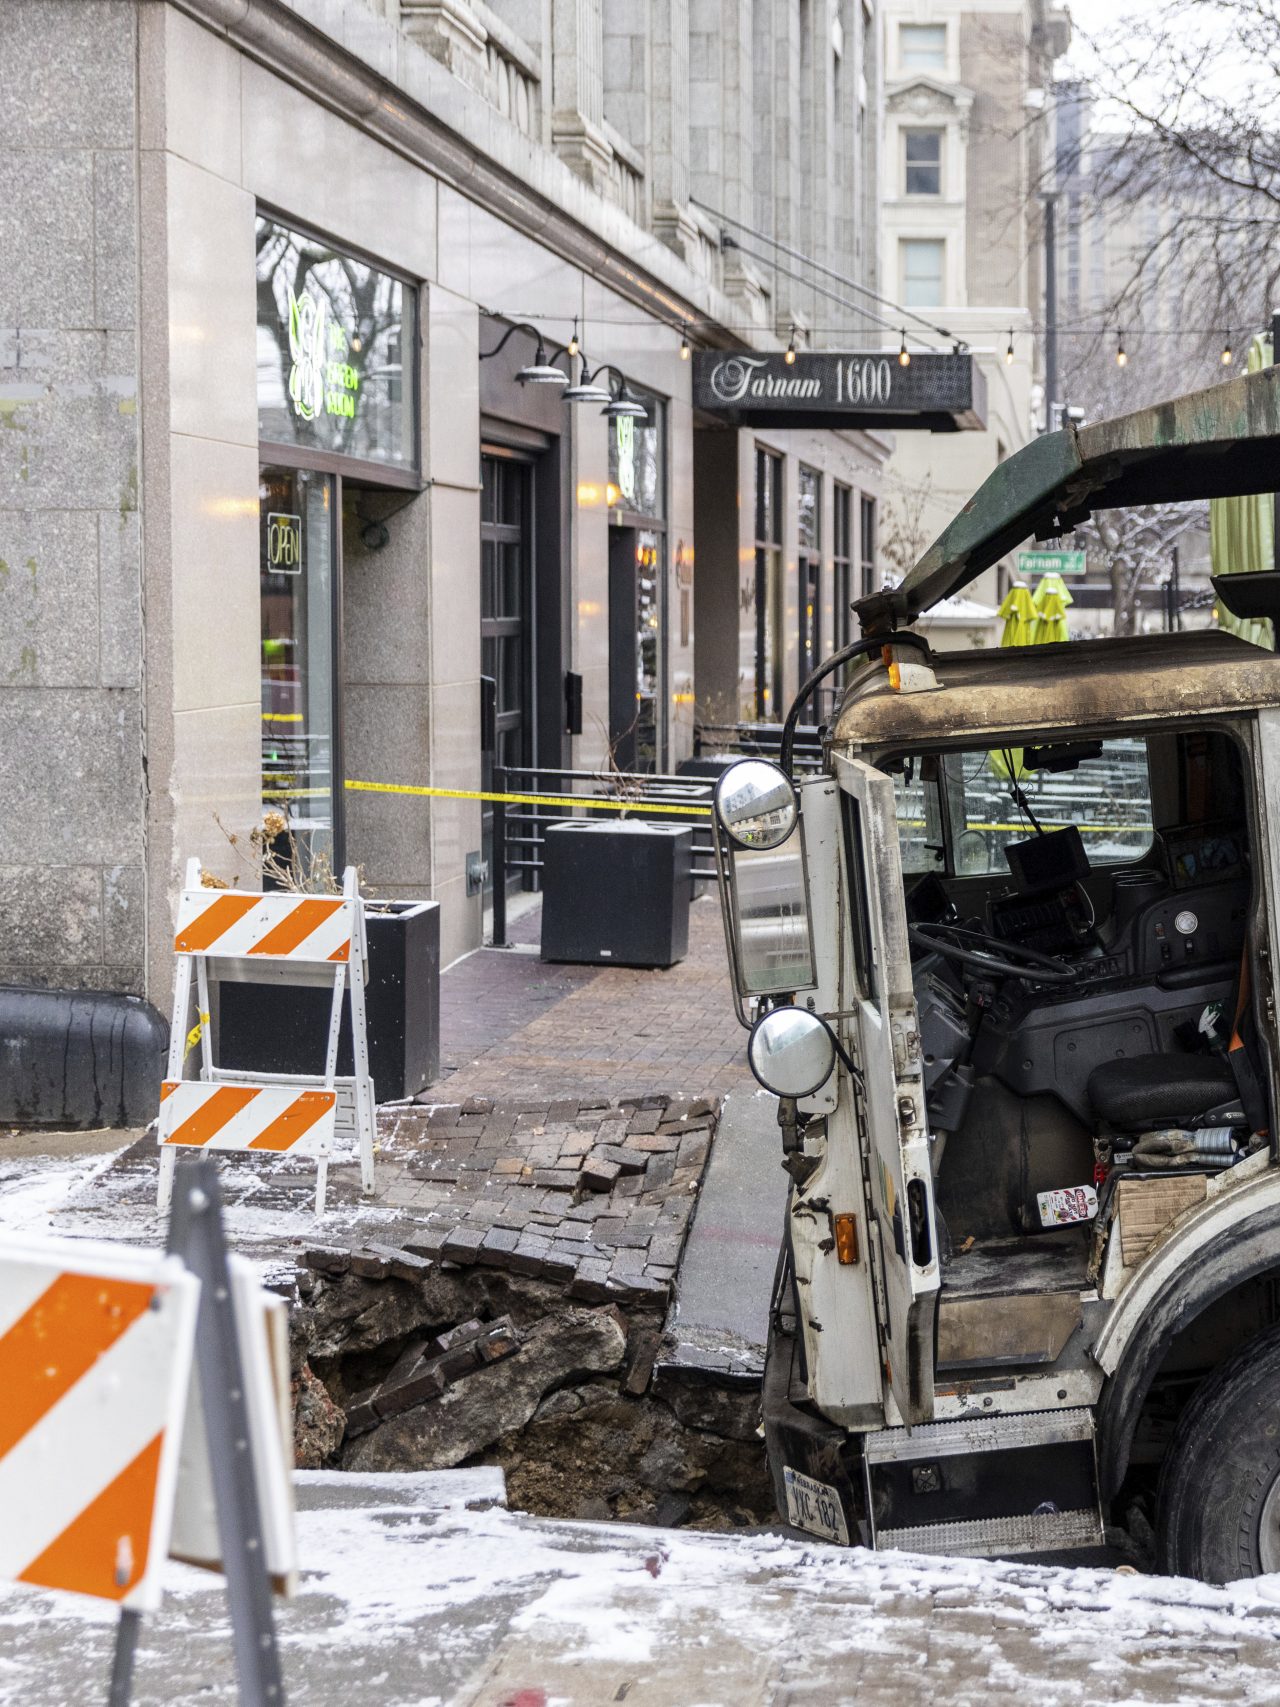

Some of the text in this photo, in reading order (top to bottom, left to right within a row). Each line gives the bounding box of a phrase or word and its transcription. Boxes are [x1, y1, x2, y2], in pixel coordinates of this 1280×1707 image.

[711, 356, 891, 403] Farnam 1600
[270, 523, 299, 565] OPEN
[1020, 555, 1062, 570] Farnam
[816, 1497, 839, 1532] 182
